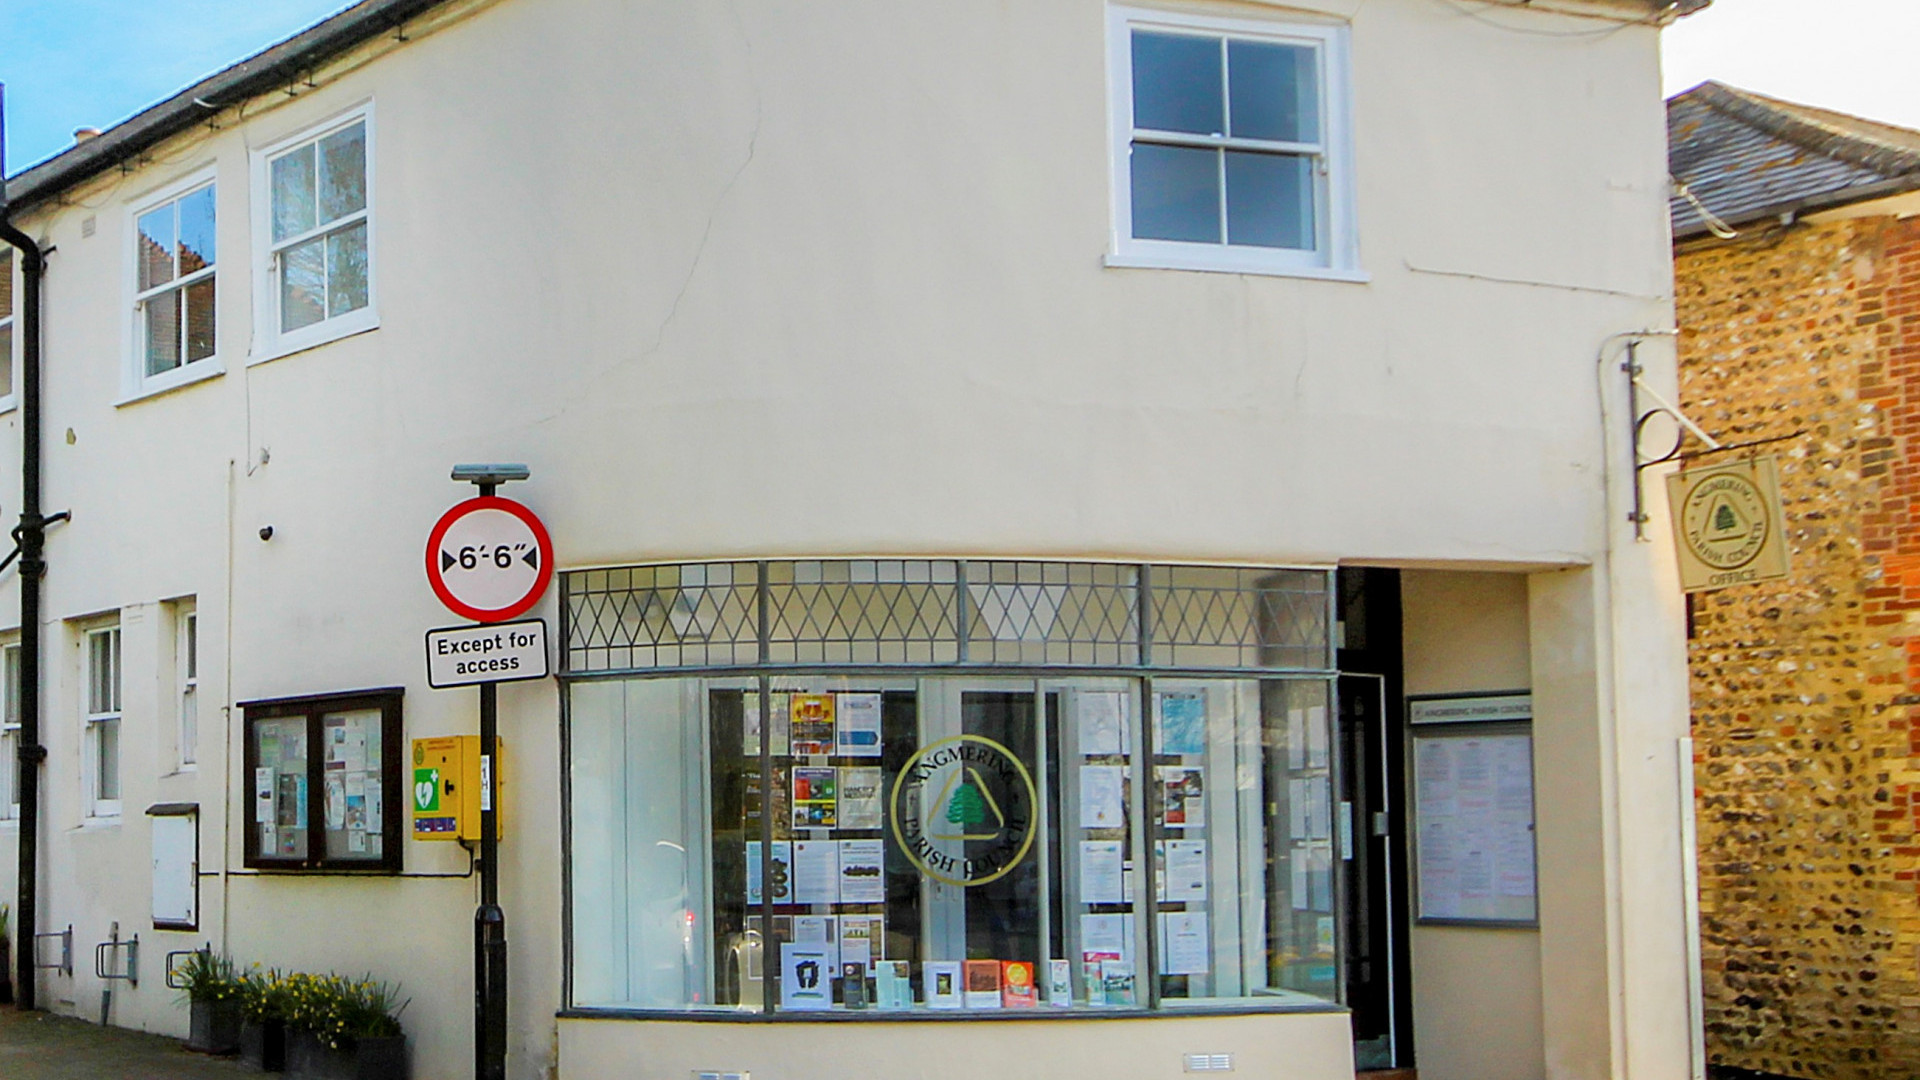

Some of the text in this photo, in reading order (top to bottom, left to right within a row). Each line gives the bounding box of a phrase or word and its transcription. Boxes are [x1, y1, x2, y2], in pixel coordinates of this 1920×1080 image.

[1708, 568, 1757, 586] OFFICE
[437, 632, 537, 655] Except for
[456, 656, 520, 675] access
[905, 817, 955, 873] PARISH
